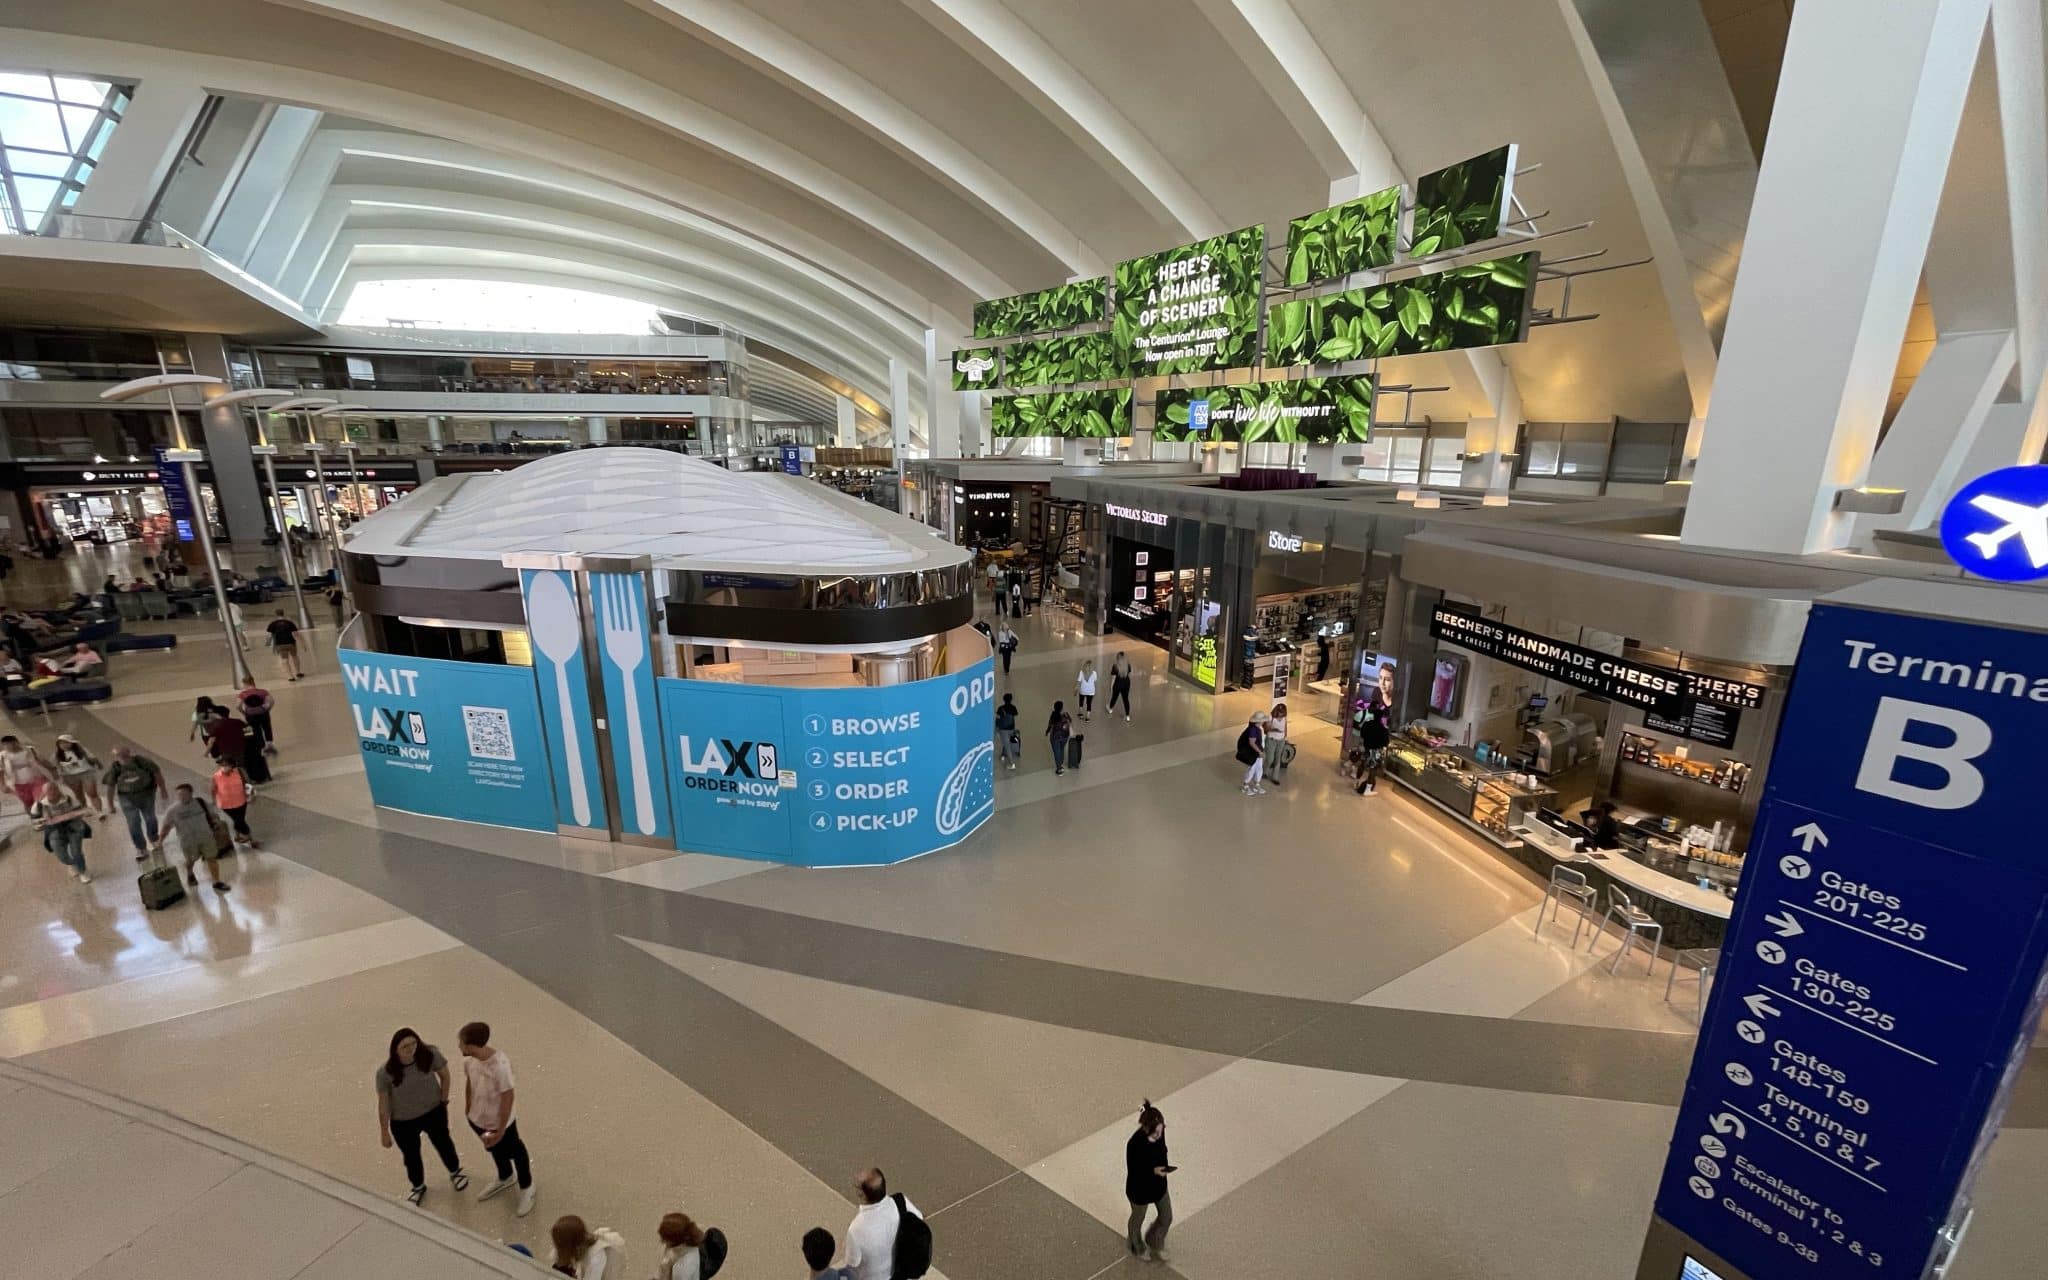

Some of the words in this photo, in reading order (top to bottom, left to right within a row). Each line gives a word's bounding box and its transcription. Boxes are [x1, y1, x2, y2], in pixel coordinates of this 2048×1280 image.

[1159, 254, 1210, 282] HERE'S
[1147, 288, 1157, 305] A
[1160, 274, 1220, 302] CHANGE
[1140, 308, 1159, 327] OF
[1161, 295, 1228, 323] SCENERY
[1135, 337, 1149, 348] The
[1145, 350, 1162, 362] Now
[1164, 348, 1184, 361] open
[1184, 346, 1194, 358] in
[1194, 342, 1216, 357] TBIT.
[1211, 409, 1235, 420] DON'T
[1234, 402, 1257, 423] live
[1259, 400, 1281, 423] life
[1281, 406, 1320, 417] WITHOUT
[1106, 503, 1141, 521] VICTORIA'S
[1141, 510, 1168, 526] SECRET
[1268, 530, 1301, 553] iStore
[1435, 611, 1503, 640] BEECHER'S
[1507, 633, 1596, 670] HANDMADE
[1600, 662, 1679, 696] CHEESE
[1441, 628, 1454, 638] MAC
[1465, 635, 1491, 650] CHEESE
[1503, 648, 1555, 672] SANDWICHES
[1569, 671, 1599, 686] SOUPS
[1616, 685, 1656, 705] SALADS
[342, 663, 419, 697] WAIT
[950, 671, 994, 715] ORD
[1709, 689, 1756, 707] CHEESE
[352, 703, 411, 744] LAX
[832, 711, 920, 735] BROWSE
[679, 734, 756, 778] LAX
[833, 746, 910, 768] SELECT
[1855, 696, 1992, 810] B
[835, 779, 909, 799] ORDER
[837, 807, 918, 831] PICK-UP
[1820, 871, 1901, 910] Gates
[1813, 890, 1927, 941] 201-225
[1794, 958, 1871, 1000] Gates
[1791, 977, 1896, 1031] 130-225
[1773, 1039, 1846, 1084] Gates
[1770, 1056, 1869, 1115] 148-159
[1764, 1082, 1867, 1147] Terminal
[1757, 1103, 1777, 1123] 4,
[1785, 1116, 1805, 1138] 5,
[1814, 1132, 1830, 1148] 6
[1836, 1144, 1854, 1163] &
[1864, 1155, 1881, 1172] 7
[1734, 1155, 1820, 1211] Escalator
[1824, 1207, 1844, 1225] to
[1722, 1198, 1773, 1235] Gates
[1777, 1231, 1818, 1263] 9-38
[1732, 1168, 1805, 1220] Terminal
[1831, 1230, 1845, 1244] 2
[1849, 1241, 1863, 1256] &
[1868, 1252, 1883, 1266] 3
